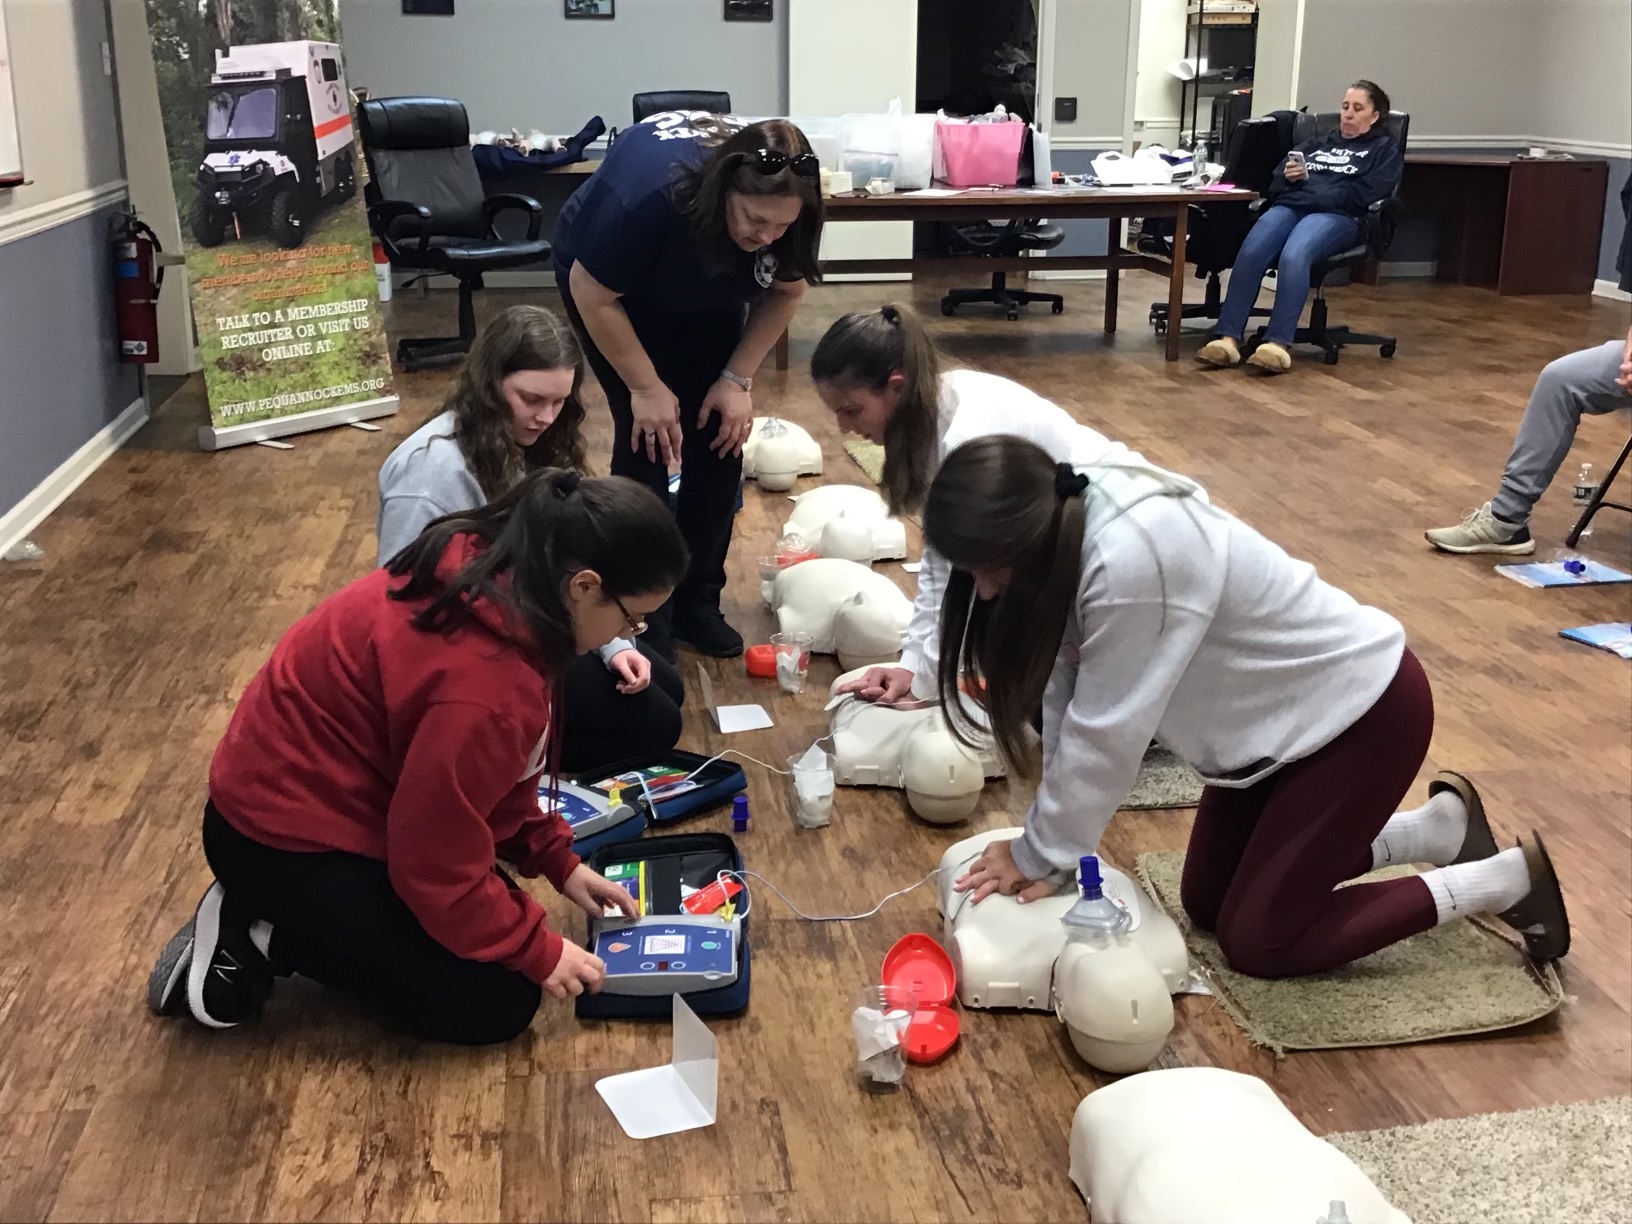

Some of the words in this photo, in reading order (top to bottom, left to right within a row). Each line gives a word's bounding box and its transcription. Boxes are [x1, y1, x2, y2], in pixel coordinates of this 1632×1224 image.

[216, 314, 250, 331] TALK
[252, 312, 271, 326] TO
[274, 309, 285, 323] A
[287, 299, 368, 321] MEMBERSHIP
[221, 328, 293, 348] RECRUITER
[296, 324, 316, 338] OR
[318, 318, 351, 335] VISIT
[353, 316, 369, 330] US
[262, 342, 313, 362] ONLINE
[316, 339, 336, 353] AT:
[219, 378, 385, 416] WWW.PEQUANNOCKEMS.ORG
